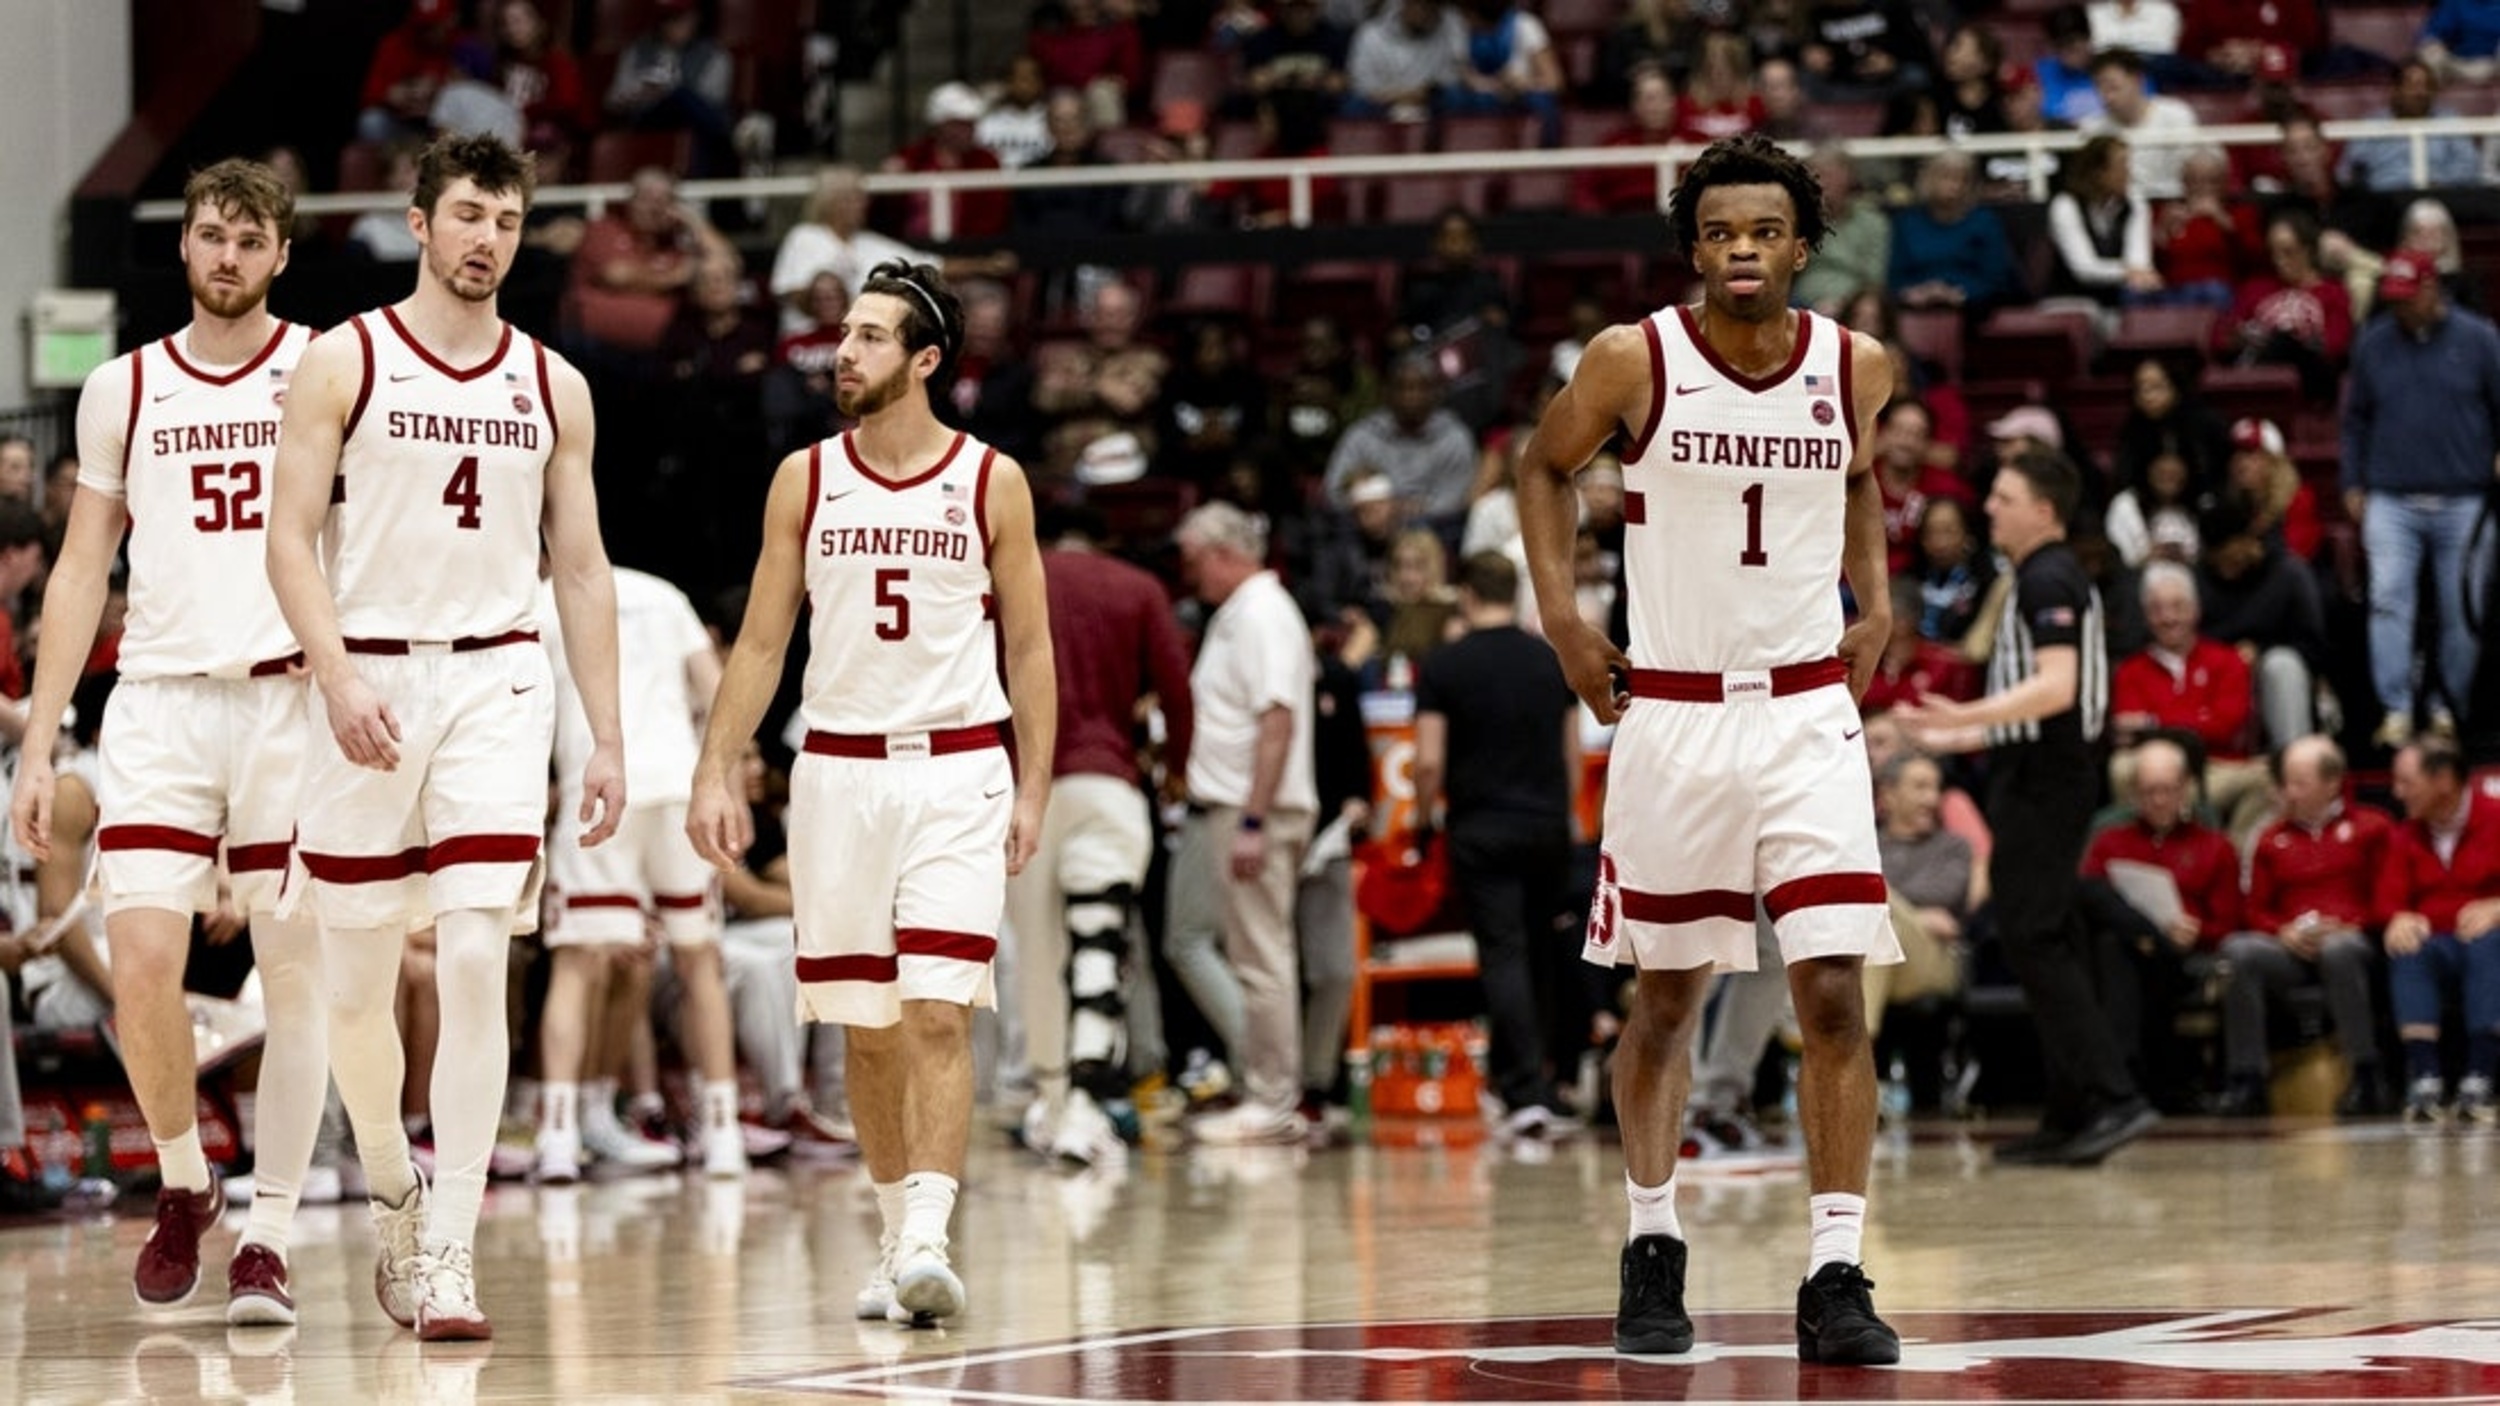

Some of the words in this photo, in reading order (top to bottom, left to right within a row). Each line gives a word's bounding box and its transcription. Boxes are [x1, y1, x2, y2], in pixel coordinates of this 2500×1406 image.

[153, 420, 283, 456] STANFOR
[389, 411, 538, 451] STANFORD
[1672, 430, 1842, 470] STANFORD
[191, 461, 264, 532] 52
[443, 456, 482, 530] 4
[821, 528, 968, 561] STANFORD
[1740, 483, 1769, 567] 1
[875, 568, 910, 641] 5
